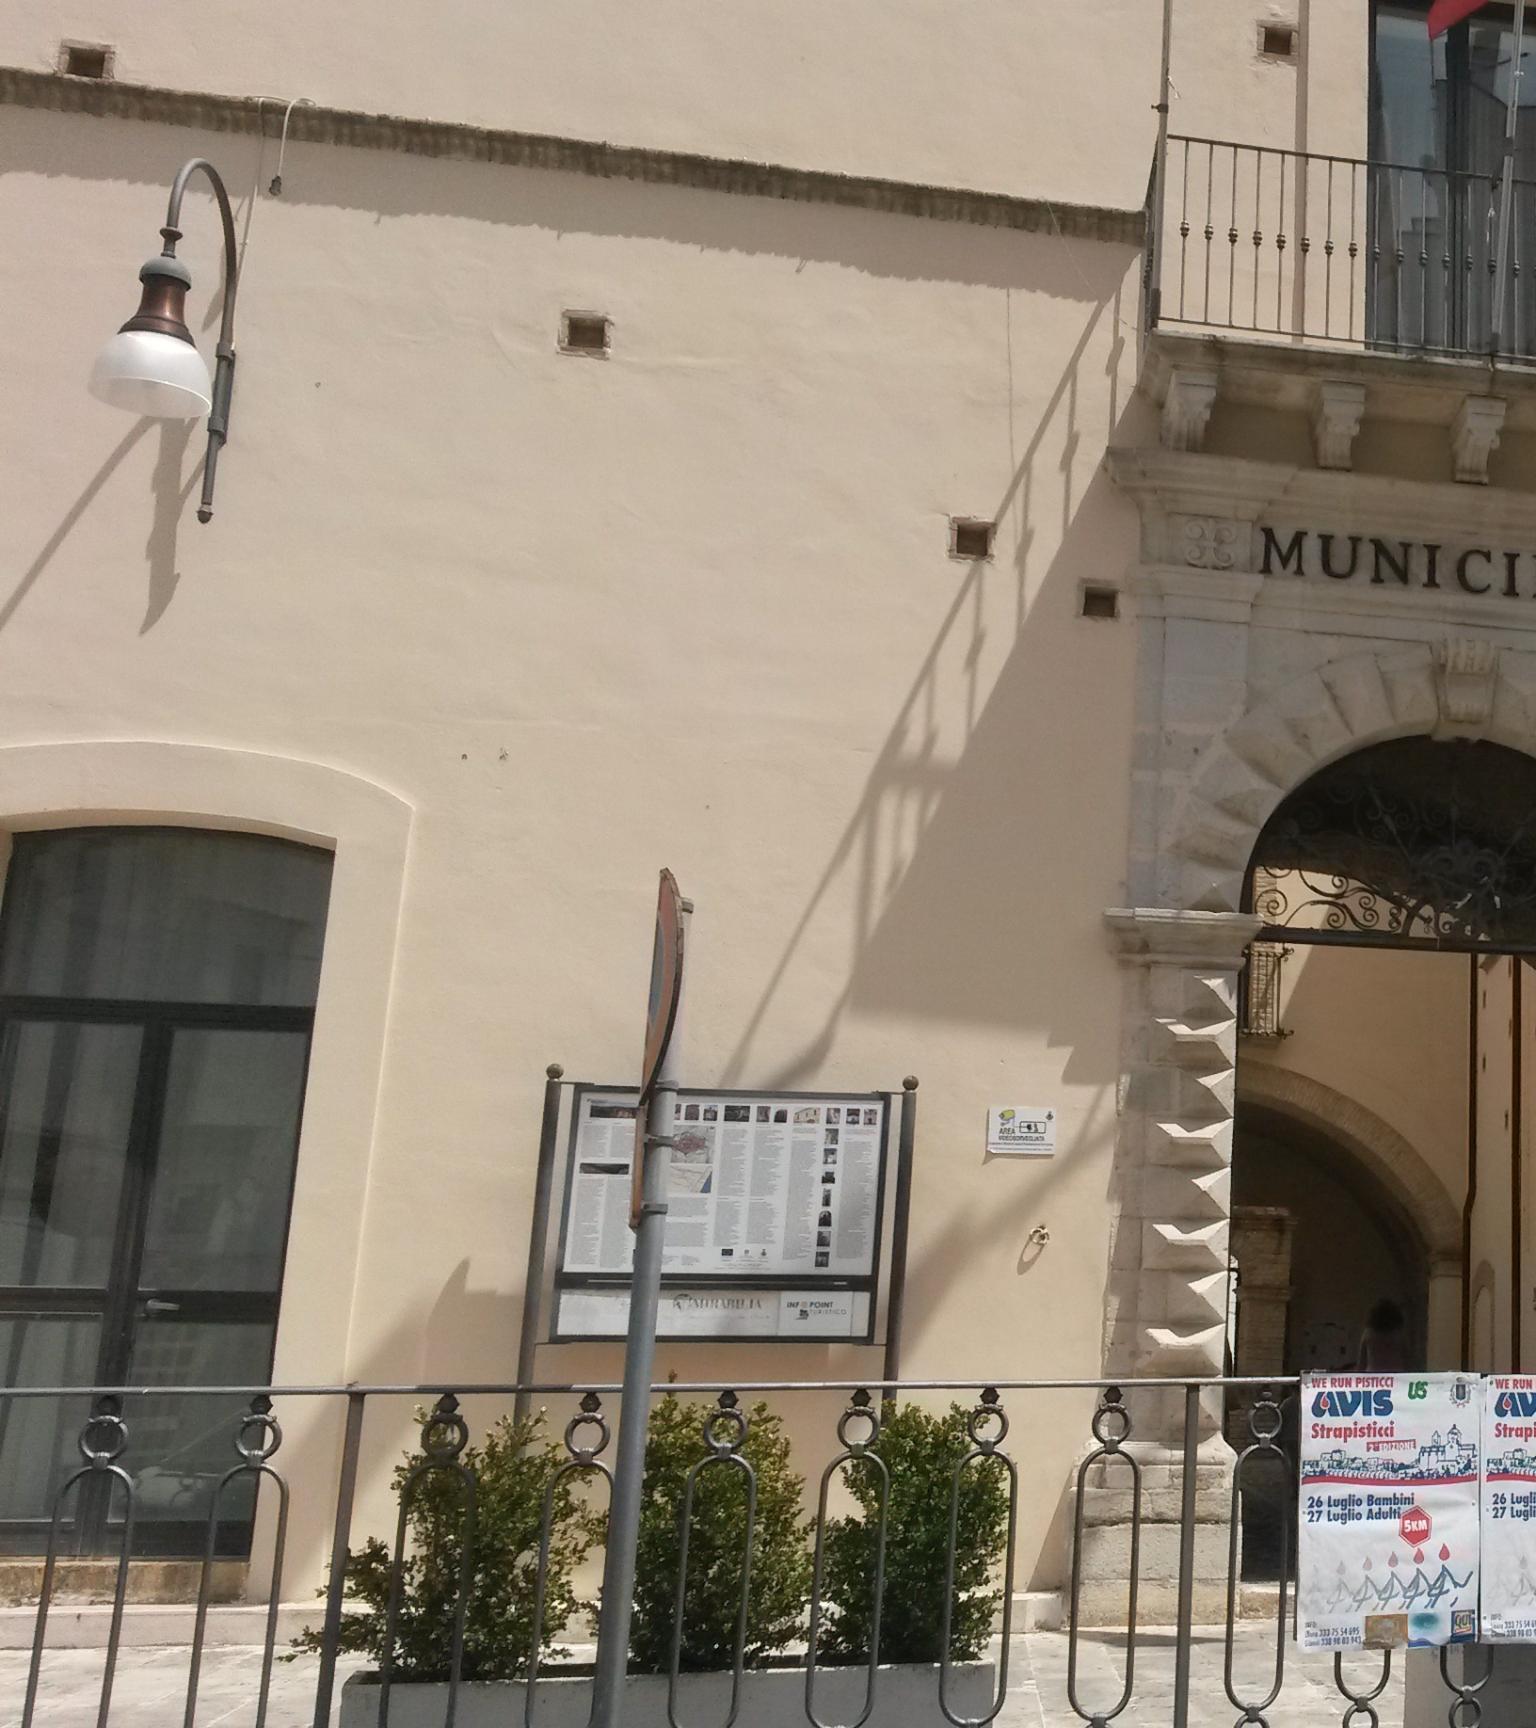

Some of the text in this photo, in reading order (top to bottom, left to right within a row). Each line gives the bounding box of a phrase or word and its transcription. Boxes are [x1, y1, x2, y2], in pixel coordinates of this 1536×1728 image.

[999, 1127, 1016, 1135] AREA
[809, 1301, 834, 1309] POINT
[1311, 1376, 1394, 1388] WE RUN PISTICCI
[1495, 1379, 1510, 1389] WE
[1513, 1379, 1532, 1389] RUN
[1311, 1389, 1394, 1417] AVIS
[1311, 1421, 1394, 1443] Strapisticci
[1307, 1493, 1414, 1511] 26 Luglio Bambini
[1492, 1493, 1507, 1504] 26
[1307, 1507, 1401, 1525] 27 Luglio Adulti
[1492, 1506, 1507, 1518] 27
[1404, 1519, 1428, 1533] 5KM
